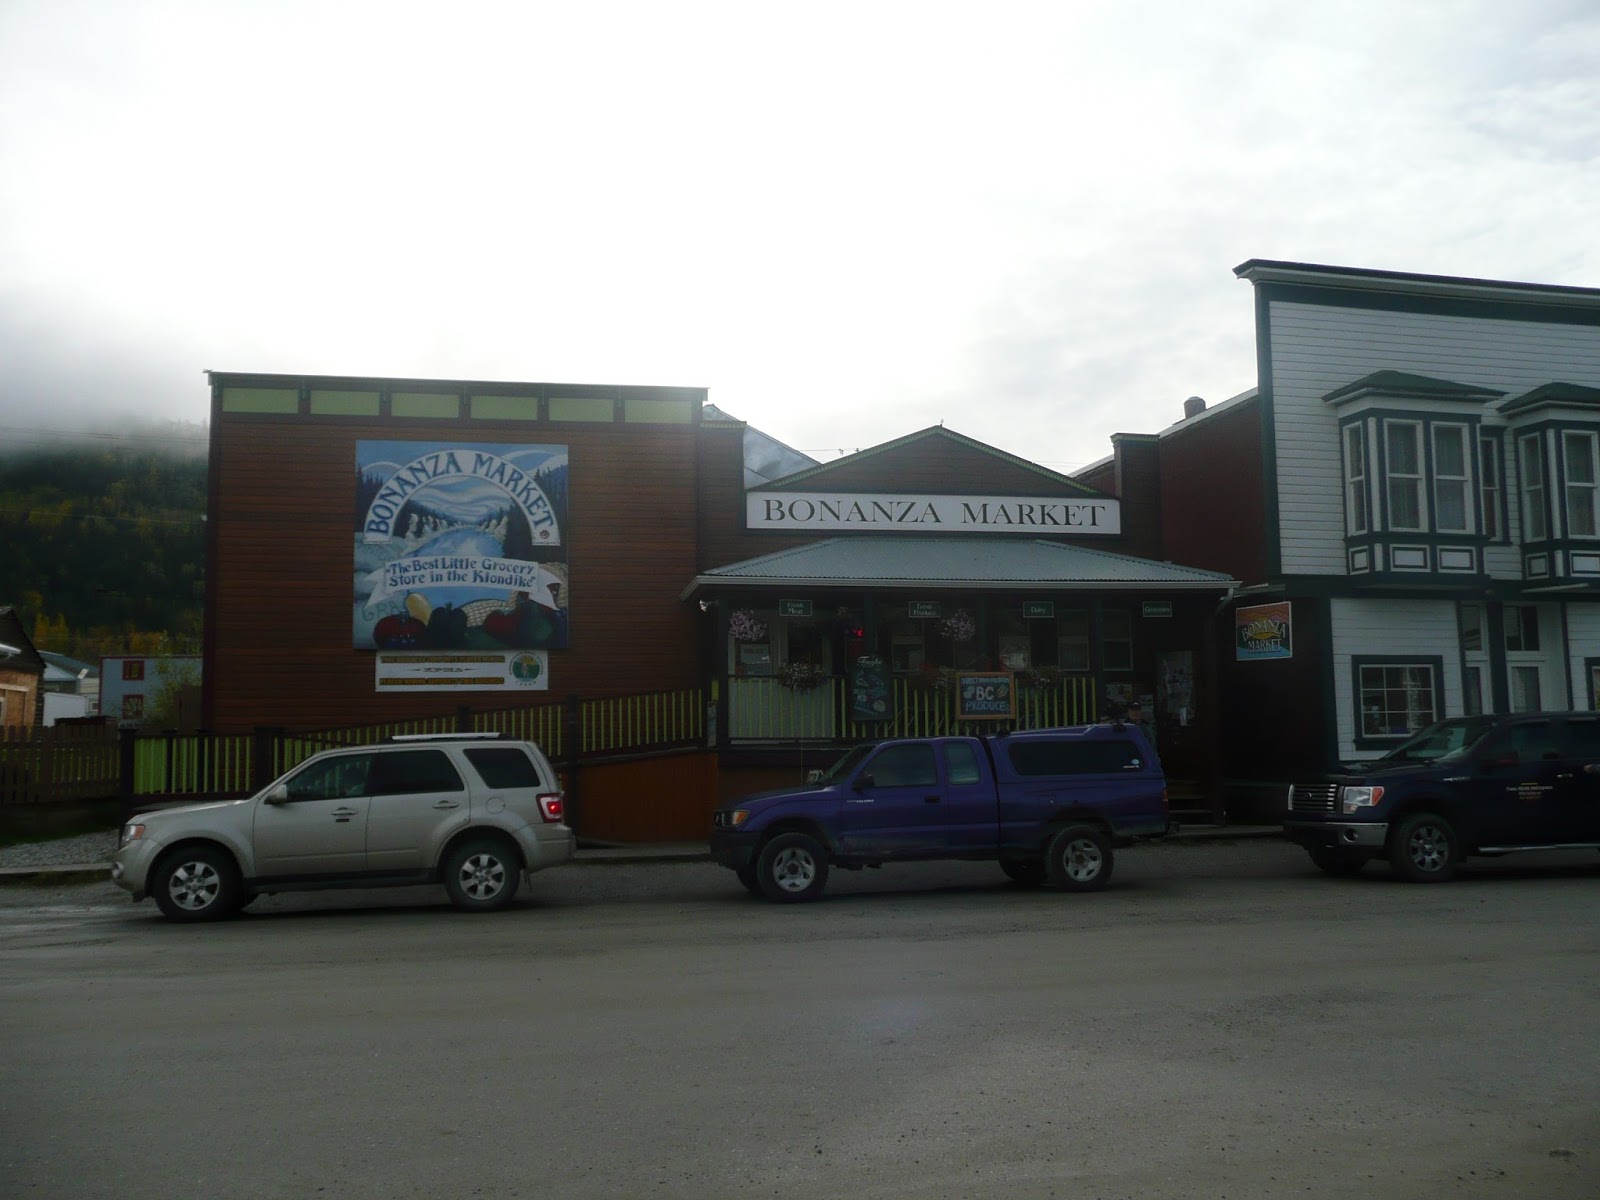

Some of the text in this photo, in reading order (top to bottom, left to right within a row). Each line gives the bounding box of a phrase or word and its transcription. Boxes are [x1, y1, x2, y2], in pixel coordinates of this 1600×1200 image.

[367, 452, 554, 536] BONANZA MARKET
[763, 499, 1105, 527] BONANZA MARKET
[413, 558, 438, 572] Best
[441, 557, 477, 570] Little
[481, 558, 534, 575] Grocery
[389, 574, 426, 587] Store
[430, 571, 443, 583] in
[447, 571, 467, 582] the
[1241, 619, 1286, 641] BONANZA
[1248, 638, 1282, 652] MARKET
[976, 686, 994, 701] BC
[965, 701, 1006, 712] PRODUCE
